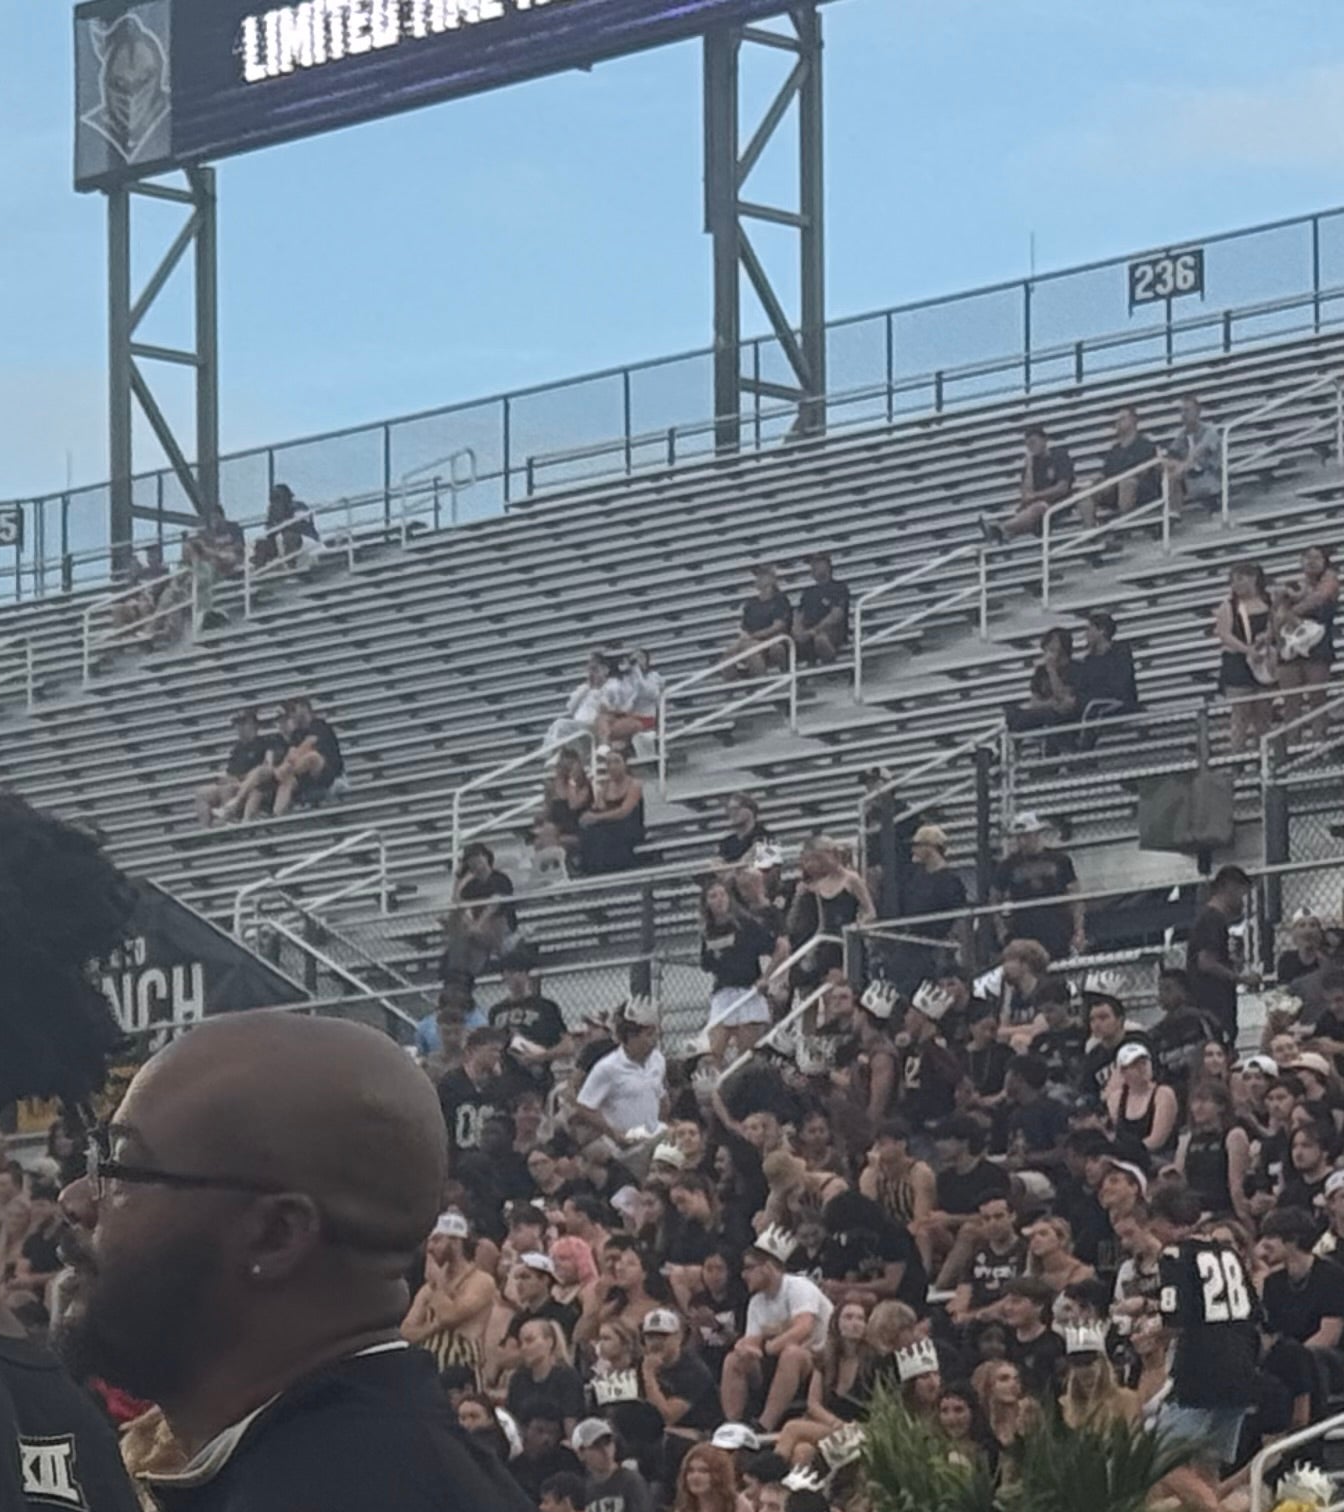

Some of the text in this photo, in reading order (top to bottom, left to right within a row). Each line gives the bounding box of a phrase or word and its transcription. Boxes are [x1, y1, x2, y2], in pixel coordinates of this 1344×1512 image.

[242, 0, 400, 82] LIMITED
[1134, 255, 1196, 300] 236
[101, 962, 204, 1033] NCH
[1196, 1250, 1252, 1322] 28
